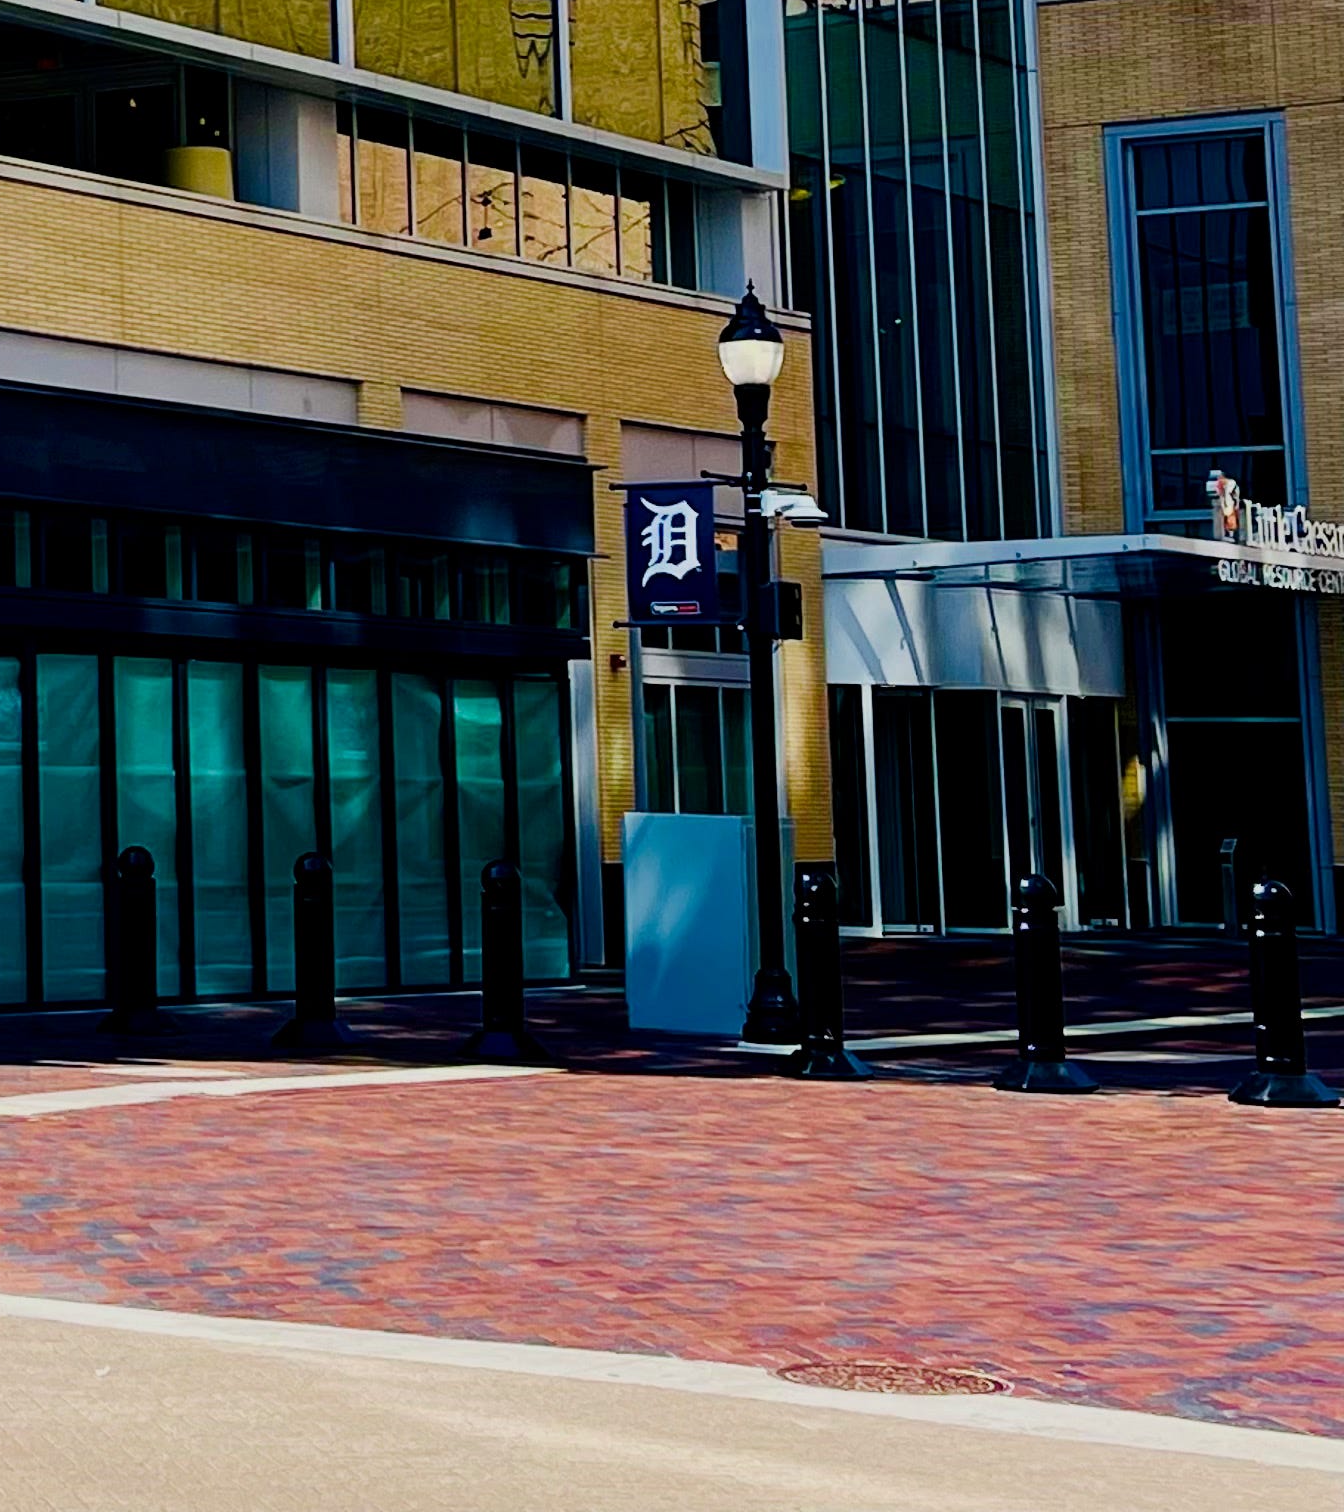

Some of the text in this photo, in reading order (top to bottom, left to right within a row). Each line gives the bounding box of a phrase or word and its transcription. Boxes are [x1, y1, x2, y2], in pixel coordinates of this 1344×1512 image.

[640, 496, 701, 588] D
[1242, 498, 1292, 551] Little
[1218, 559, 1261, 586] GLOBAL
